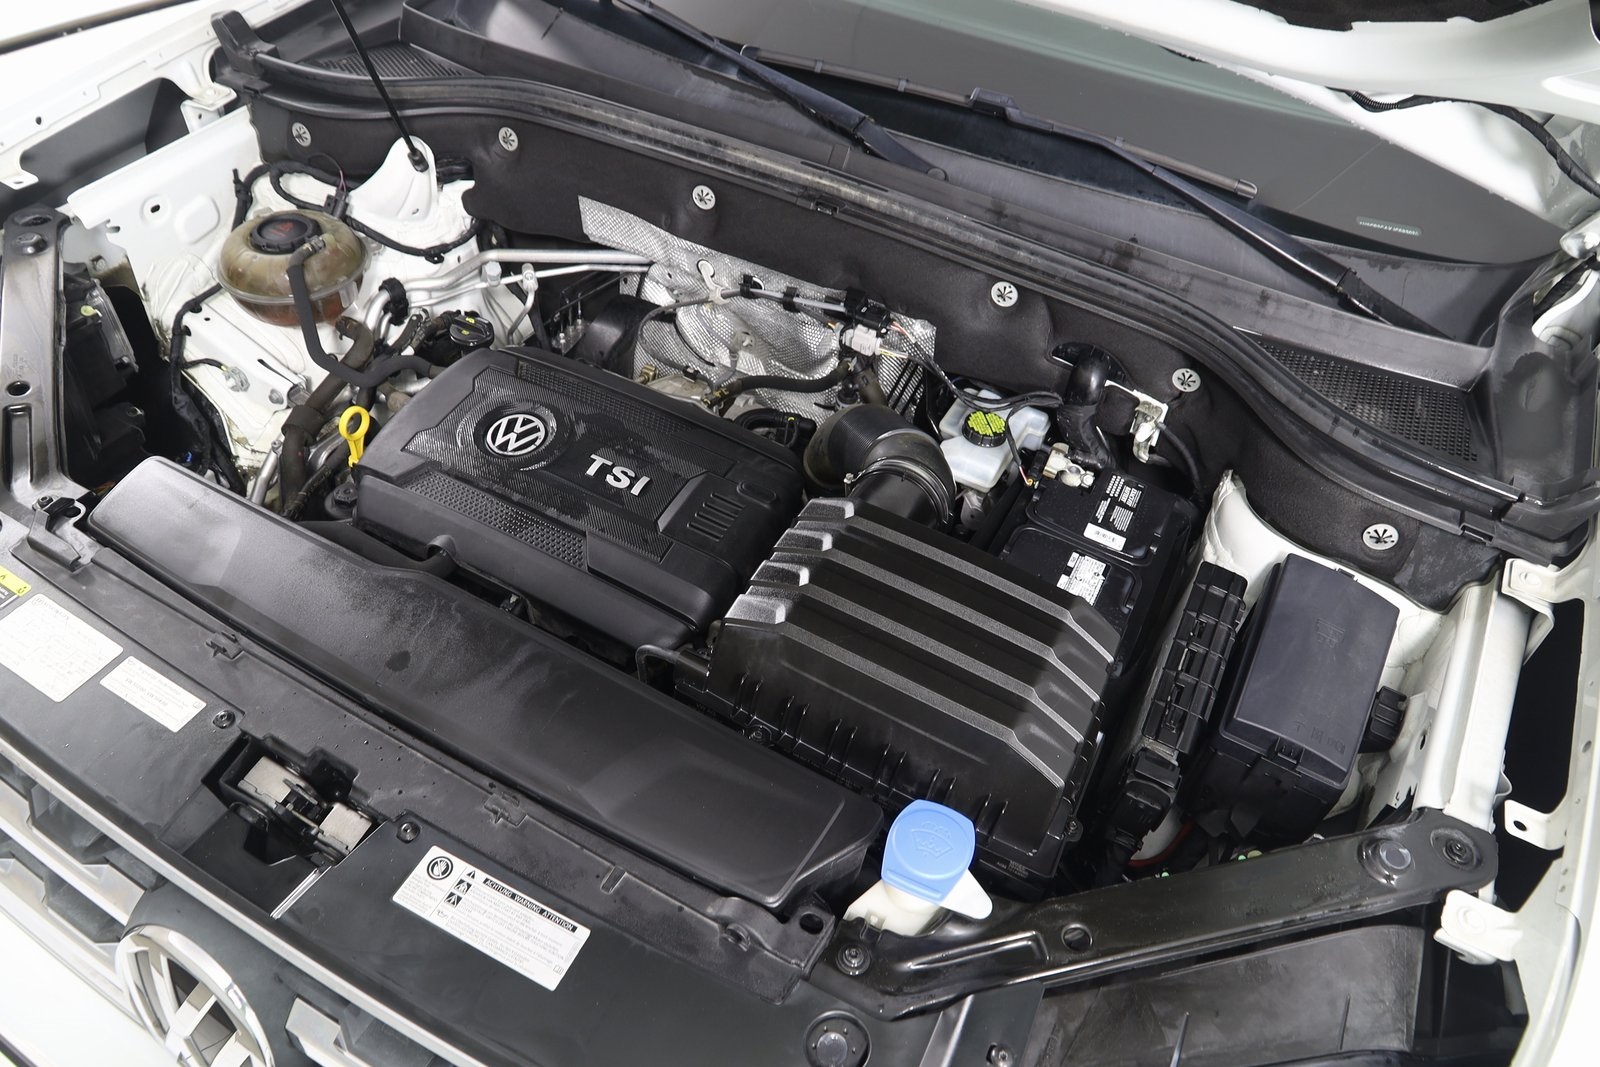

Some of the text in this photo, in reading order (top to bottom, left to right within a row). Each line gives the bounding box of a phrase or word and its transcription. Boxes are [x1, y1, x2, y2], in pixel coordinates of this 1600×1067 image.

[488, 415, 544, 454] VW
[585, 454, 650, 496] TSI
[485, 879, 574, 931] ACHTUNG WARNING ATTENTION
